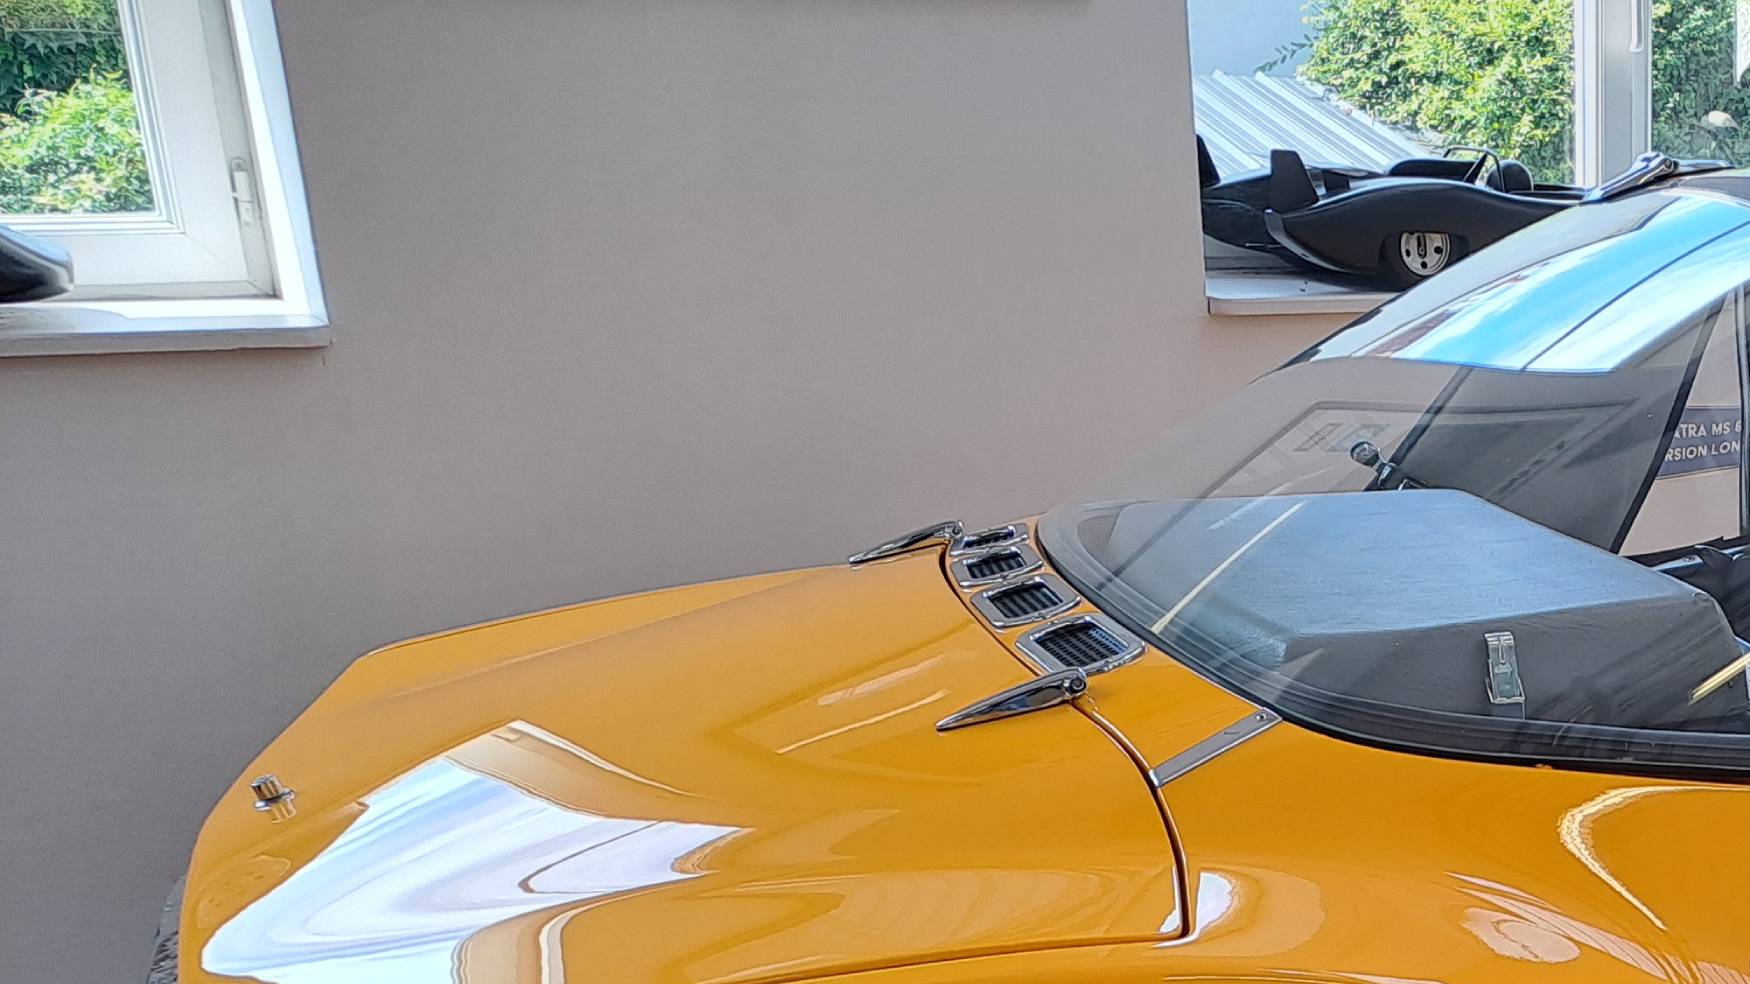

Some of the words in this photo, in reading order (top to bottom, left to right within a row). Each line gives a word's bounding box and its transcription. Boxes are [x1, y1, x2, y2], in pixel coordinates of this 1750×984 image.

[1711, 421, 1731, 436] MS
[1664, 444, 1708, 462] RSION
[1711, 440, 1742, 456] LON
